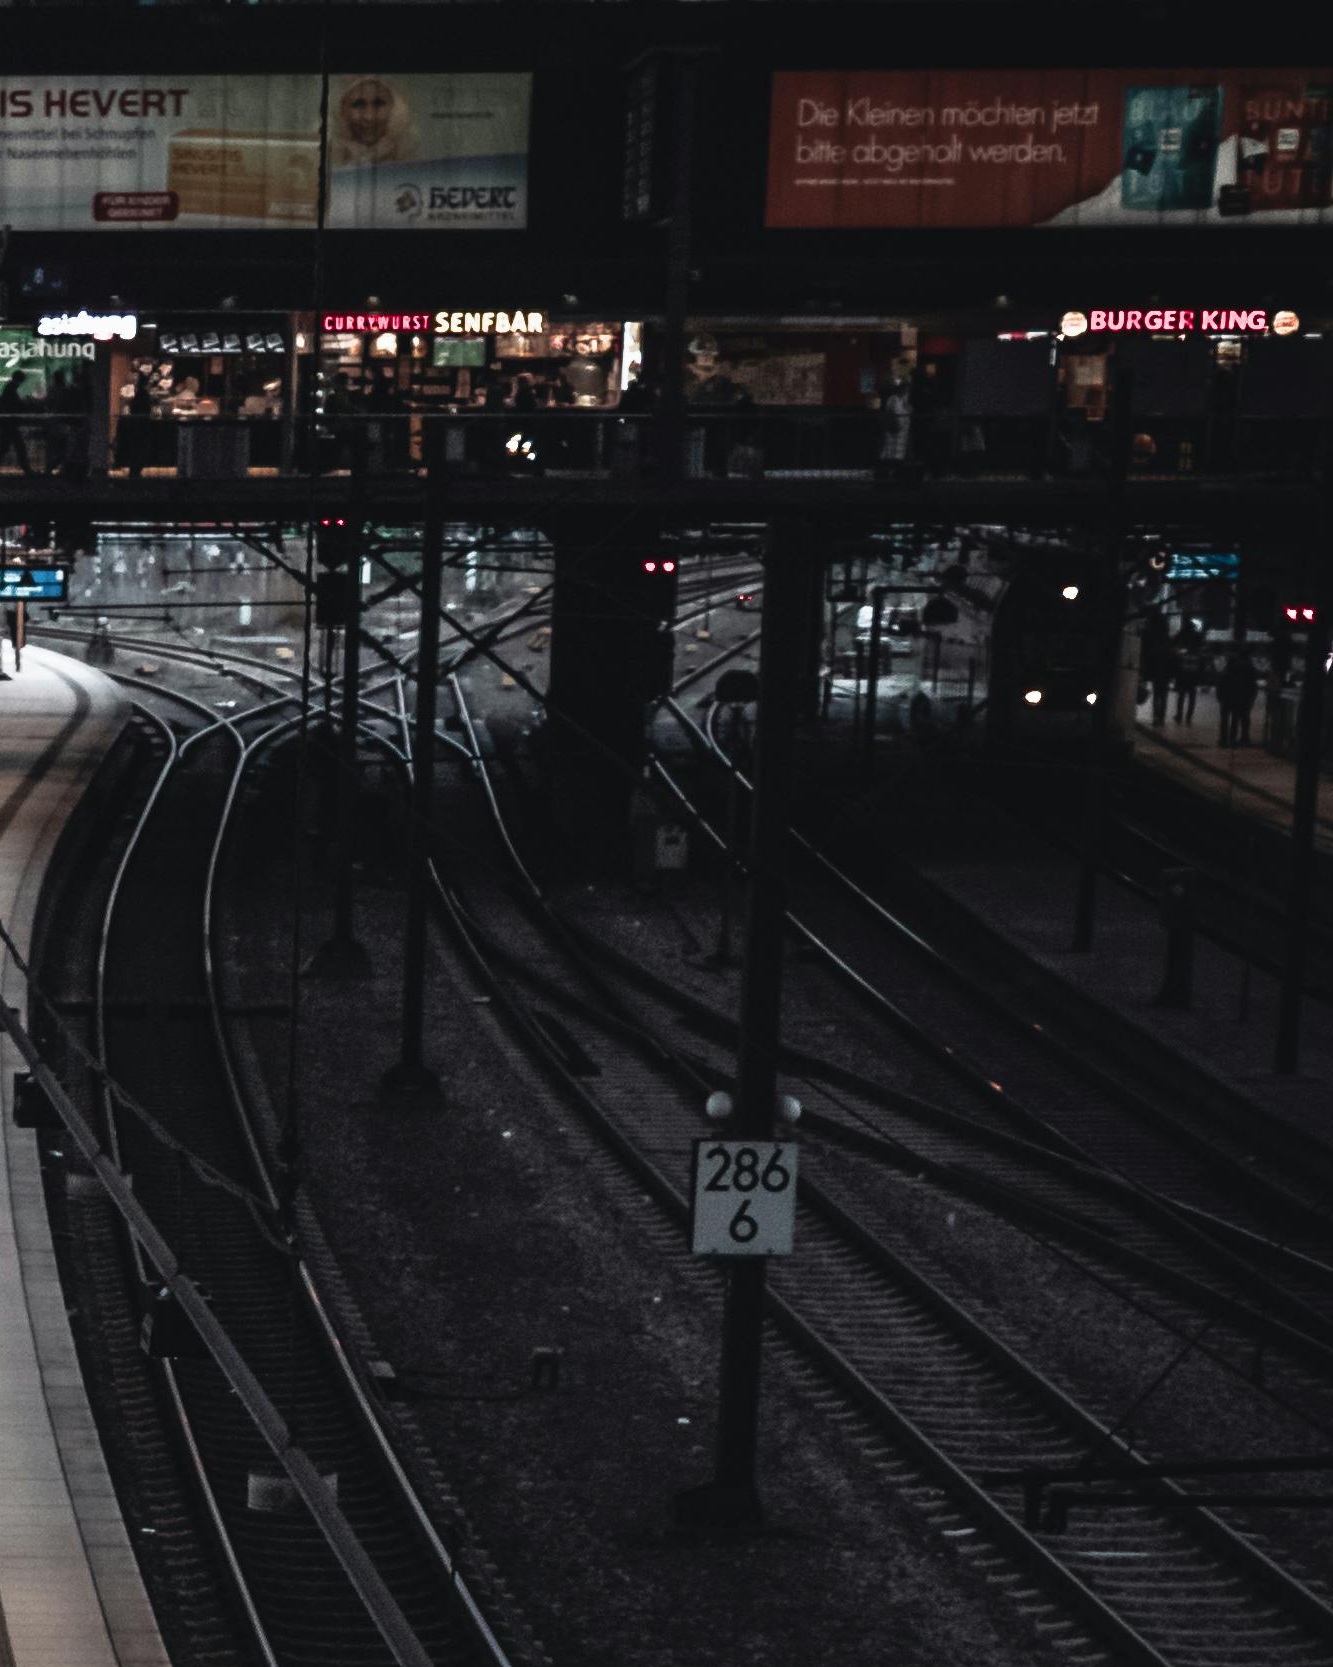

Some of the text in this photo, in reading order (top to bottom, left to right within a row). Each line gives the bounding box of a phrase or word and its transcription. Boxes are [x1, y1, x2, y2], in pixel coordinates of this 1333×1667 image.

[44, 89, 189, 118] HEVERT
[797, 98, 839, 127] Die
[847, 97, 935, 127] Kleinen
[942, 97, 1045, 127] möchten
[1050, 101, 1099, 134] jetzt
[796, 133, 1067, 172] bitte abgeholt werden.
[324, 310, 544, 334] CURRYWURST SENFBAR
[1090, 310, 1194, 330] BURGER
[1201, 310, 1266, 330] KING
[704, 1147, 790, 1192] 286
[729, 1199, 758, 1243] 6
